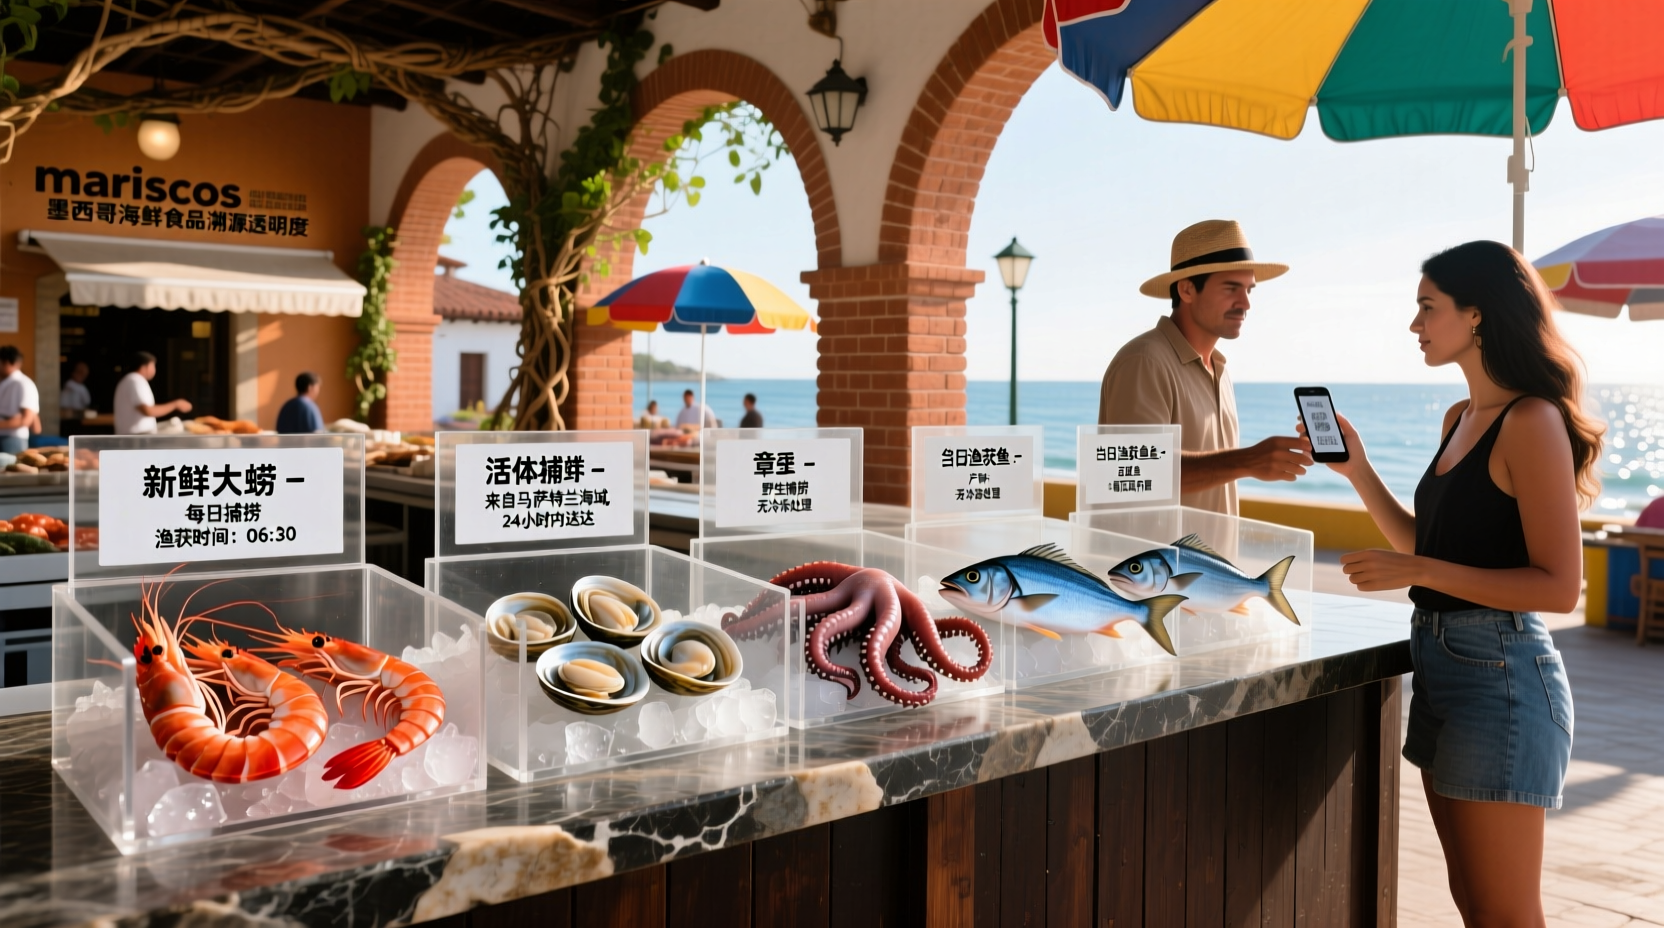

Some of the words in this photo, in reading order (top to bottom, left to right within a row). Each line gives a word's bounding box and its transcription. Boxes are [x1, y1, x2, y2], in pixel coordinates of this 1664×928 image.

[35, 165, 242, 209] mariscos
[184, 502, 262, 524] 每日捕捞
